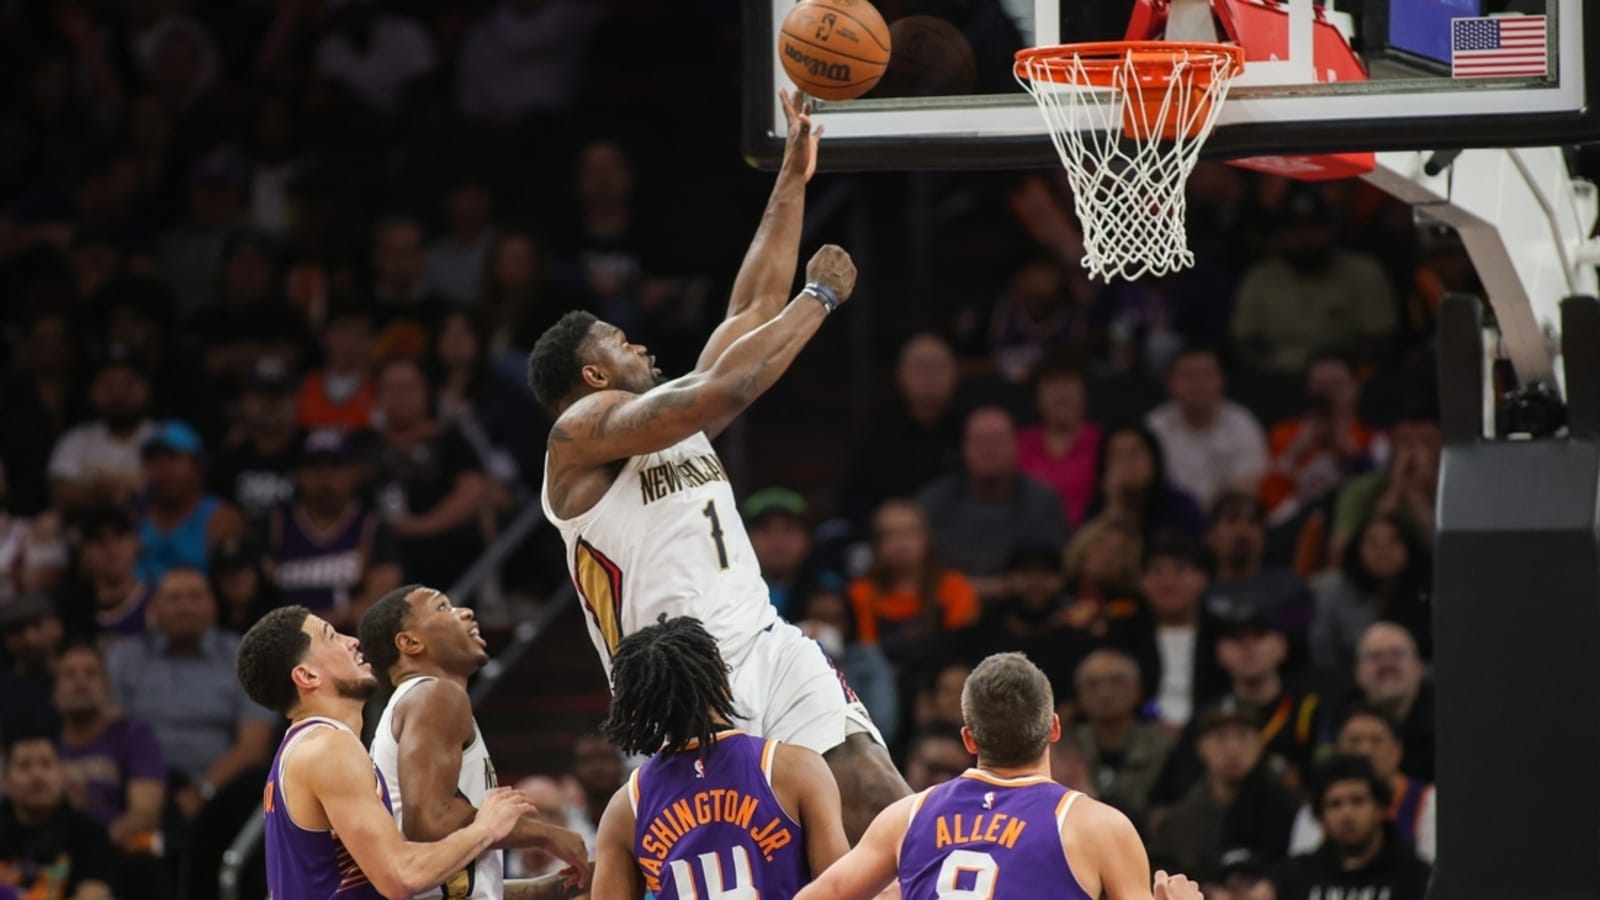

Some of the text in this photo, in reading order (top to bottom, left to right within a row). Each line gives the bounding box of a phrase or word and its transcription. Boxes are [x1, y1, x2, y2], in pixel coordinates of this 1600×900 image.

[785, 43, 850, 81] Wilson
[639, 460, 683, 506] NEW
[703, 499, 729, 570] 1
[750, 817, 792, 863] JR.
[936, 813, 1027, 849] ALLEN
